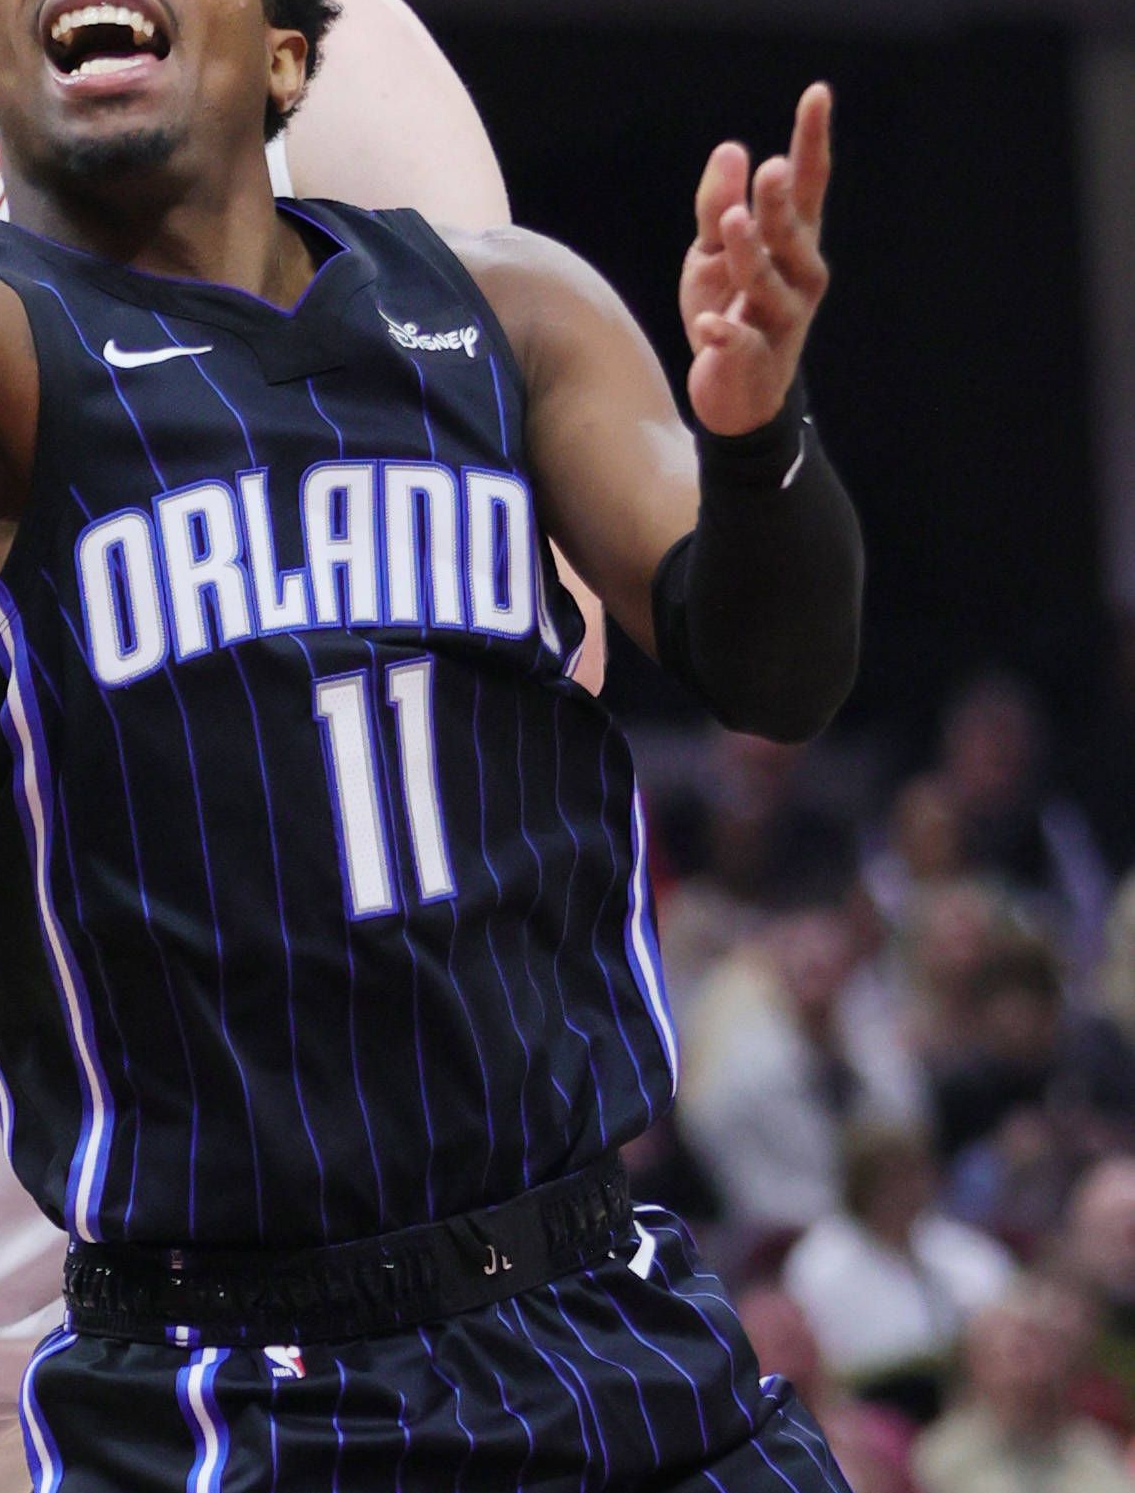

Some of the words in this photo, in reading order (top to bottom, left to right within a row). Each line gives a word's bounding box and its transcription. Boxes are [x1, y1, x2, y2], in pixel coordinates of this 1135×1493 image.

[74, 459, 563, 690] ORLAND
[312, 654, 457, 922] 11
[271, 1367, 294, 1378] NBA
